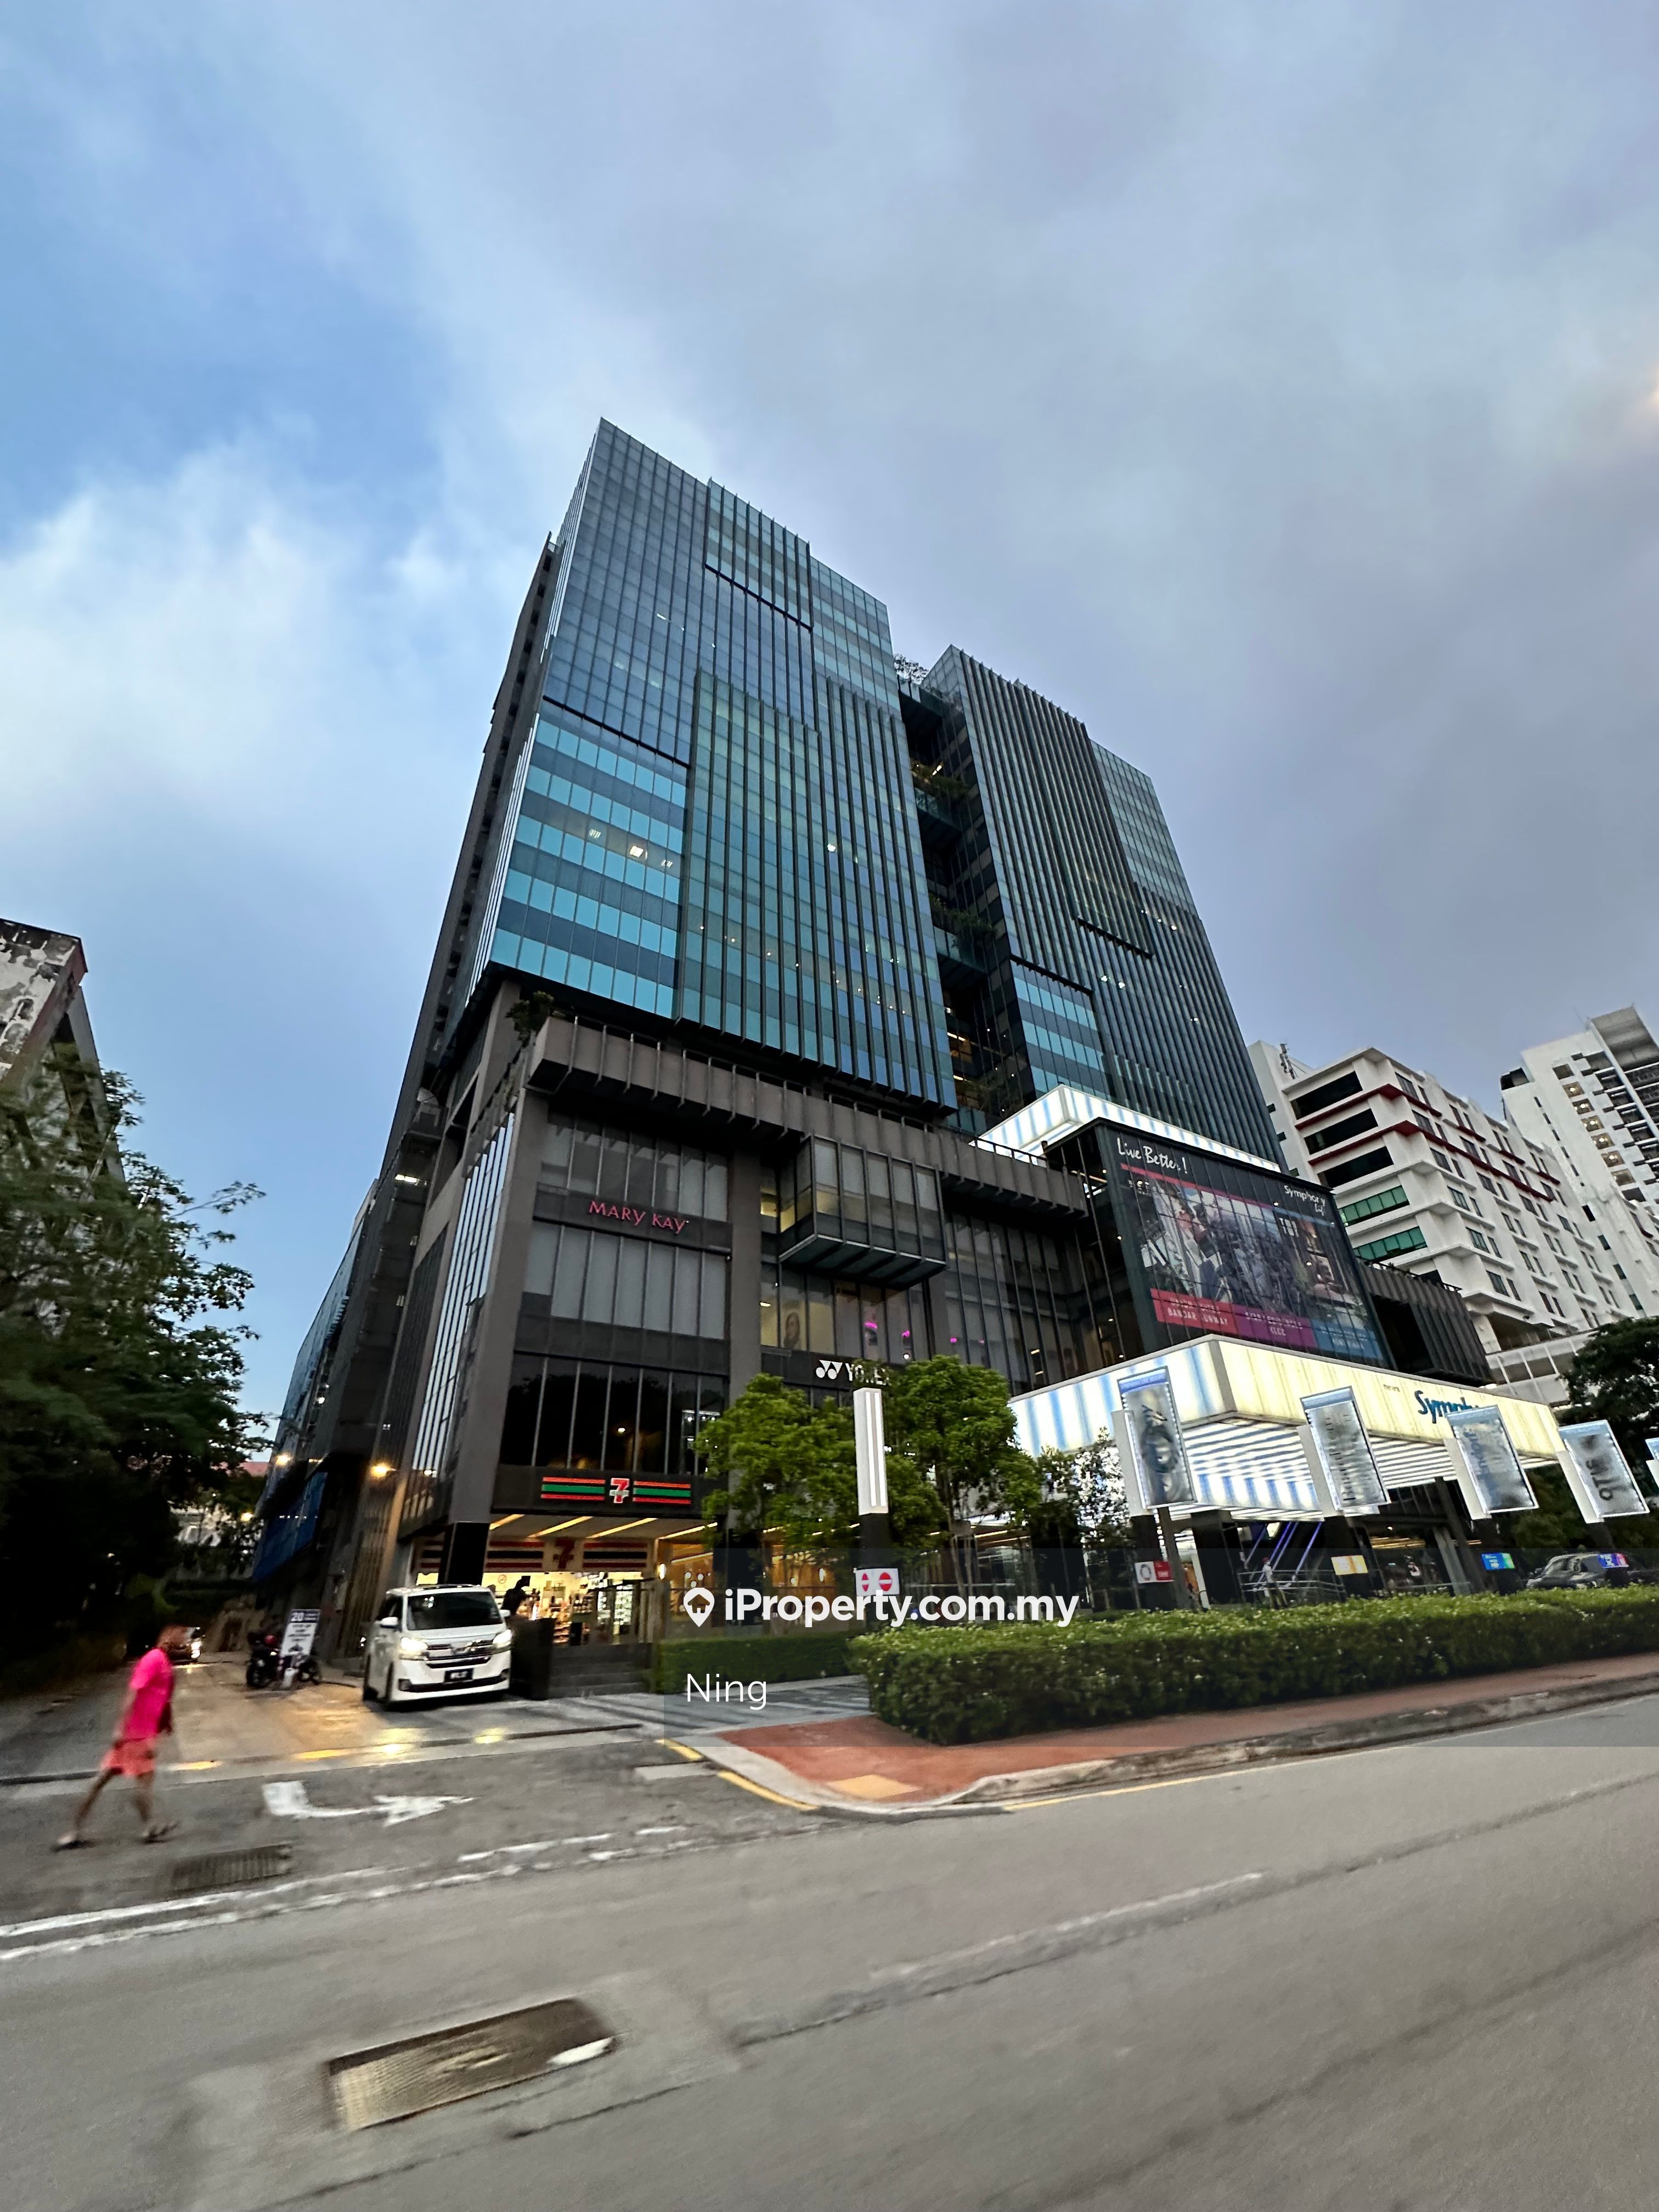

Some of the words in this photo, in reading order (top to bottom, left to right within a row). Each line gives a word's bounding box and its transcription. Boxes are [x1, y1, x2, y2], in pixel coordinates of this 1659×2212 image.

[1117, 1137, 1141, 1159] Live
[589, 1201, 646, 1226] MARY
[653, 1214, 686, 1234] KAY
